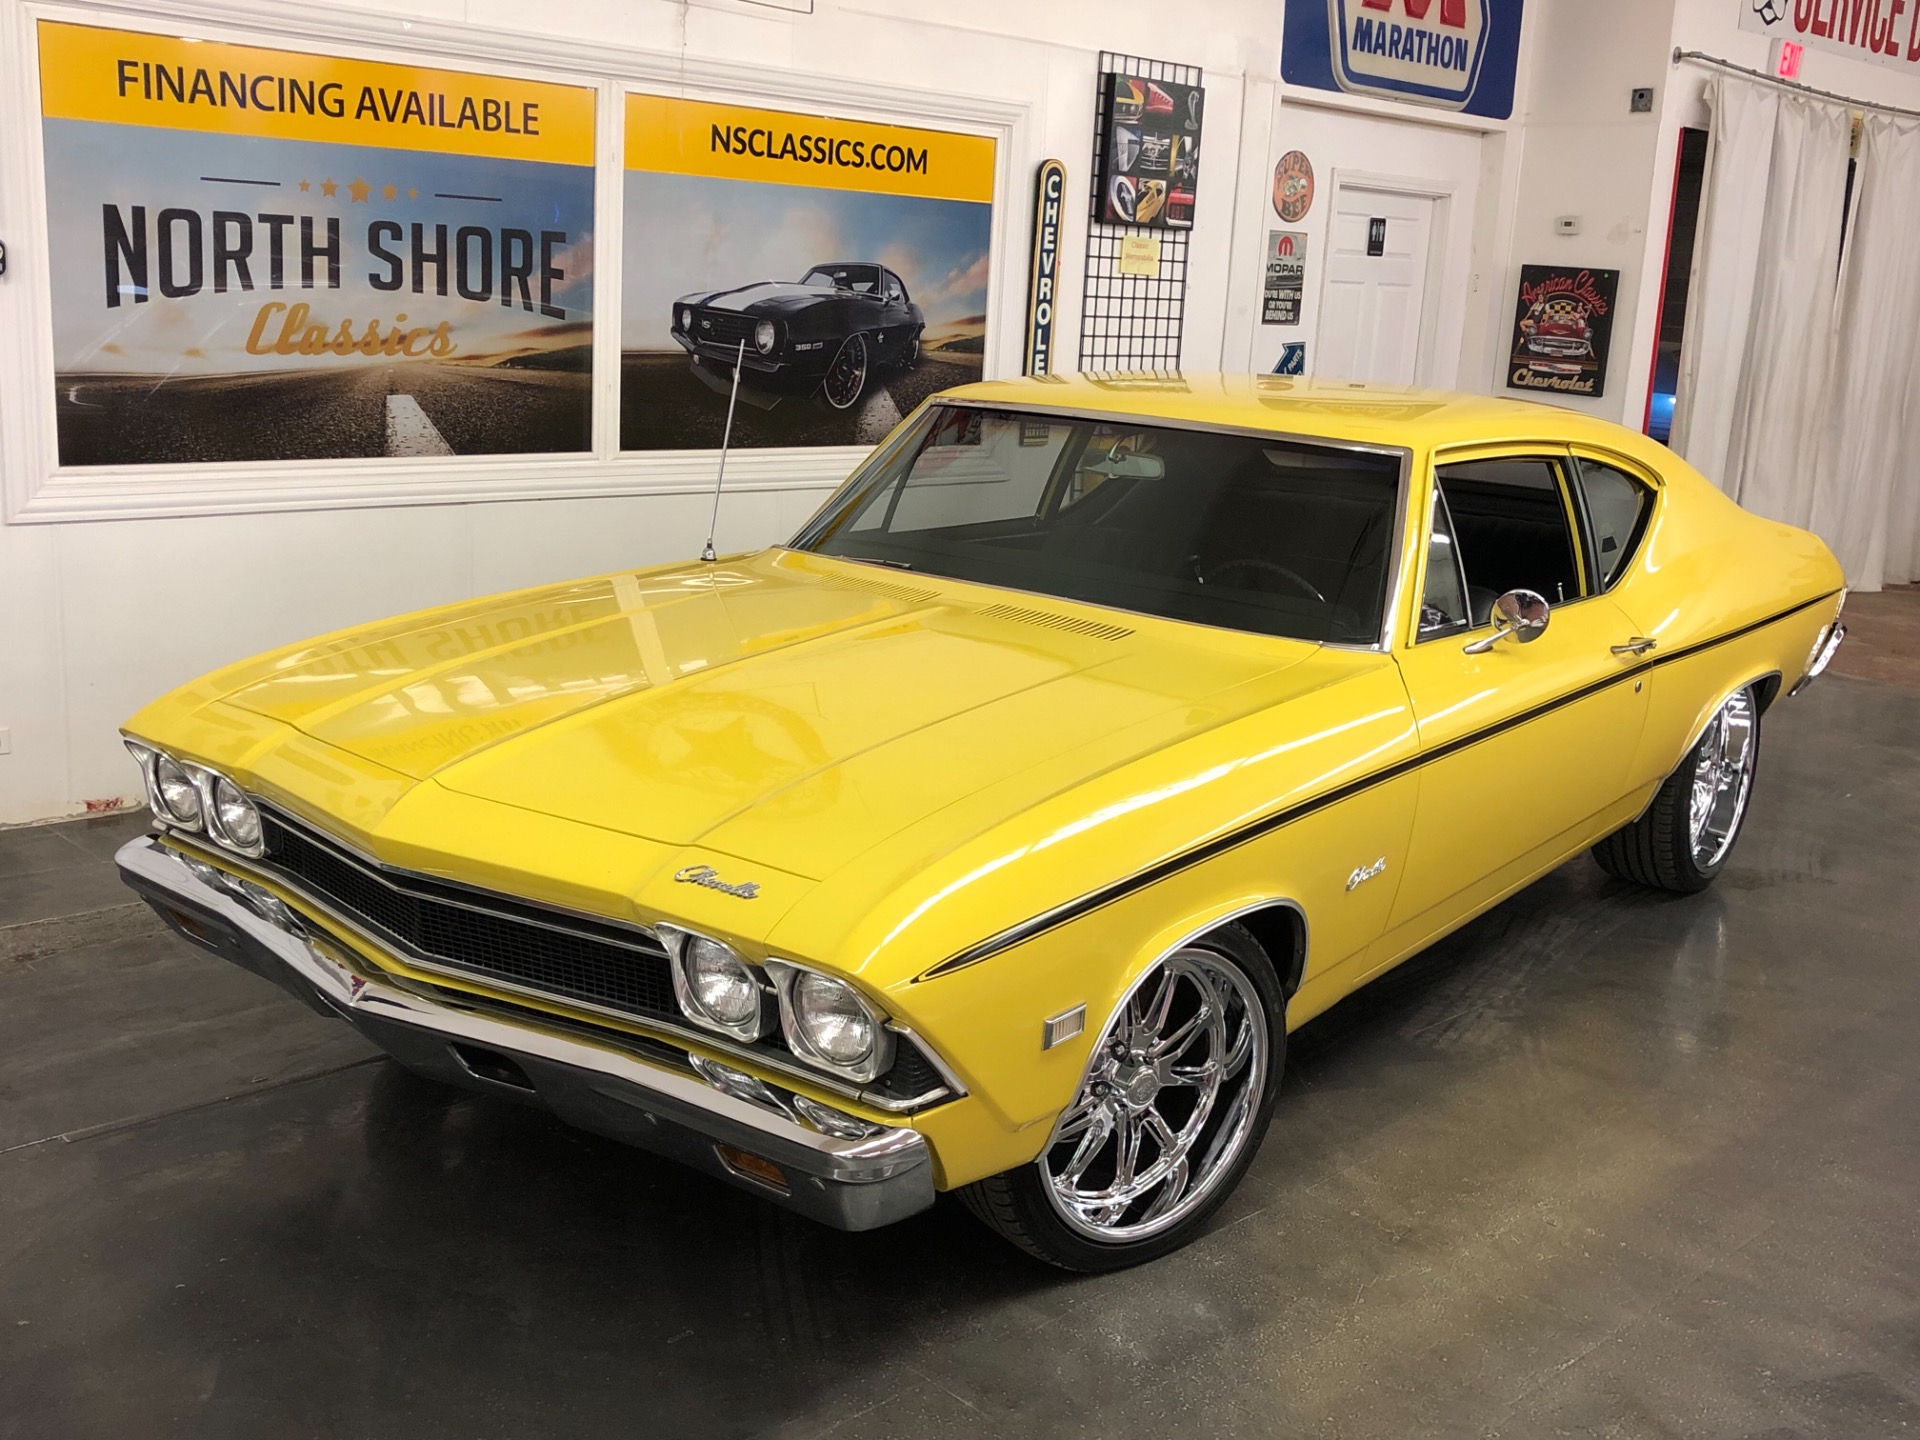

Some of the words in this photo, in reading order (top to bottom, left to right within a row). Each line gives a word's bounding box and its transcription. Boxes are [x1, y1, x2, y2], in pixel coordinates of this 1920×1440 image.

[1352, 16, 1469, 72] MARATHON
[117, 59, 345, 118] FINANCING
[354, 86, 540, 136] AVAILABLE
[711, 123, 928, 175] NSCLASSICS.COM
[1281, 194, 1307, 218] BEE
[102, 203, 341, 309] NORTH
[368, 220, 567, 321] SHORE
[1034, 175, 1060, 375] CHEVROLE
[1266, 263, 1304, 275] MOPAR
[1279, 289, 1294, 299] WITH
[1522, 277, 1572, 307] American
[1574, 270, 1608, 316] Classics
[245, 301, 459, 358] Classics
[1512, 367, 1594, 392] Chevrolet
